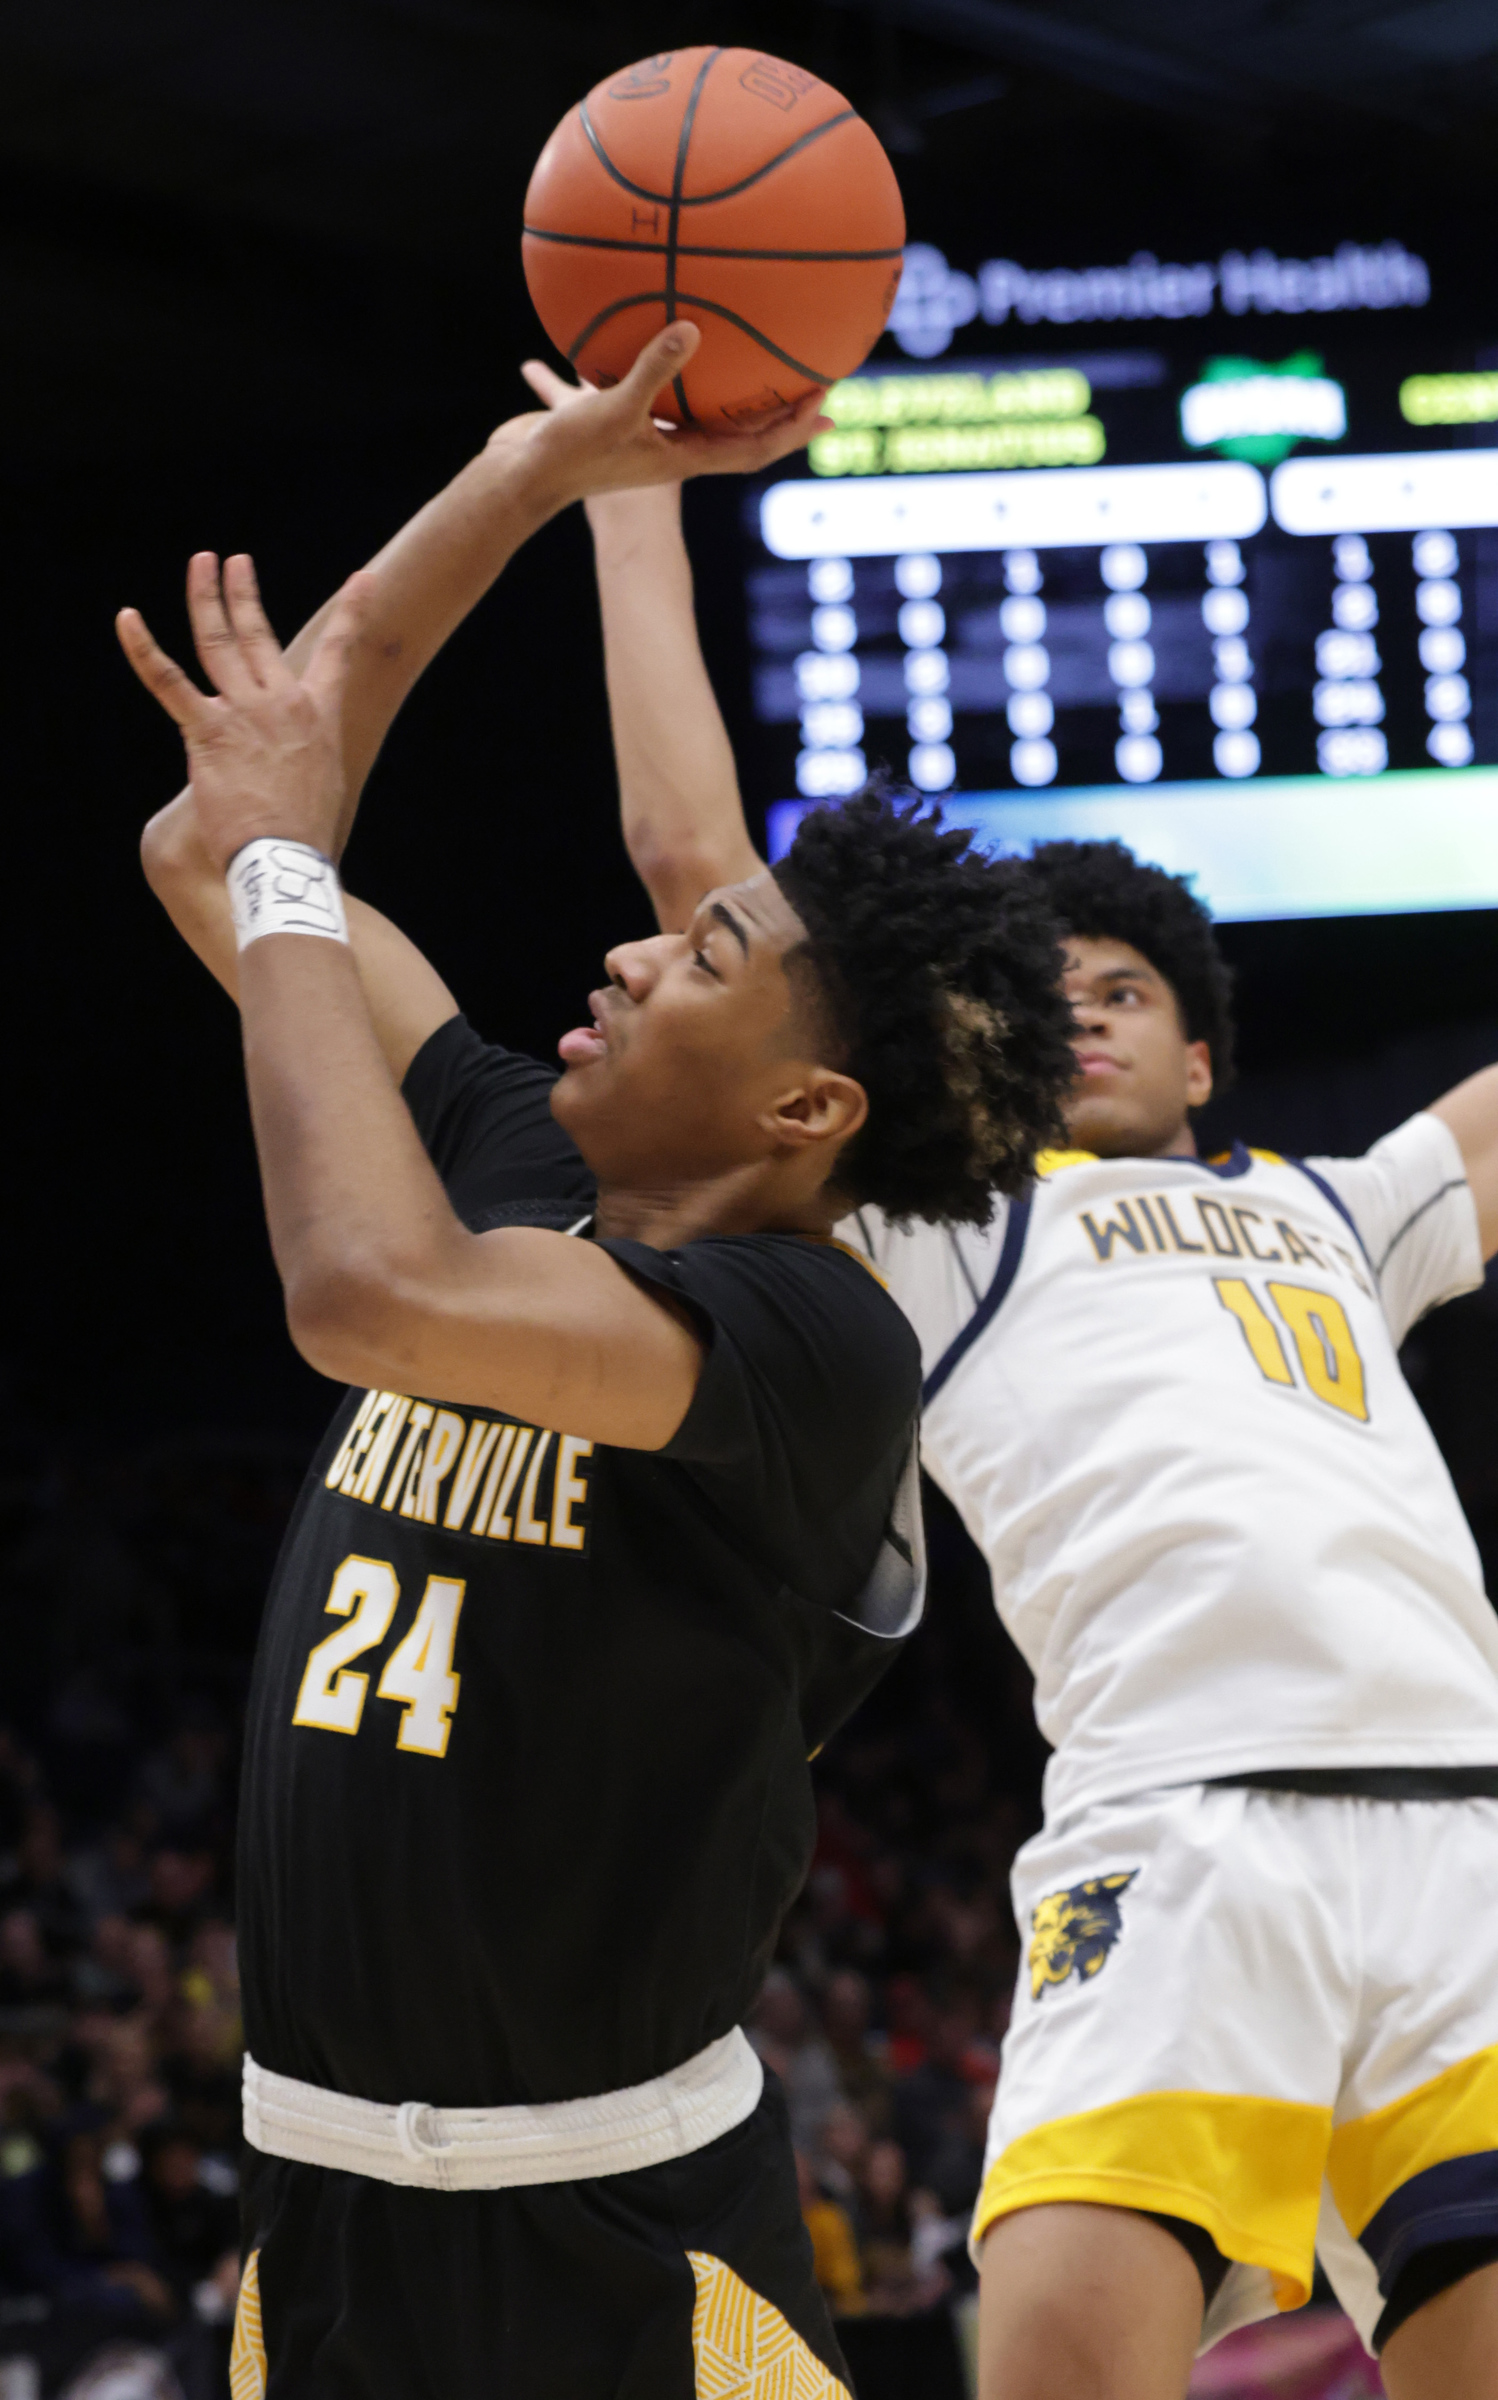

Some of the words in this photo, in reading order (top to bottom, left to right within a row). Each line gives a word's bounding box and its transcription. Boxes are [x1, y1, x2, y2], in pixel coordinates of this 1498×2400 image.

[977, 250, 1214, 325] Premier
[1219, 238, 1430, 315] Health
[1080, 1194, 1371, 1299] WILDCA
[1212, 1277, 1370, 1424] 10
[325, 1388, 595, 1550] CENTERVILLE
[292, 1554, 466, 1758] 24
